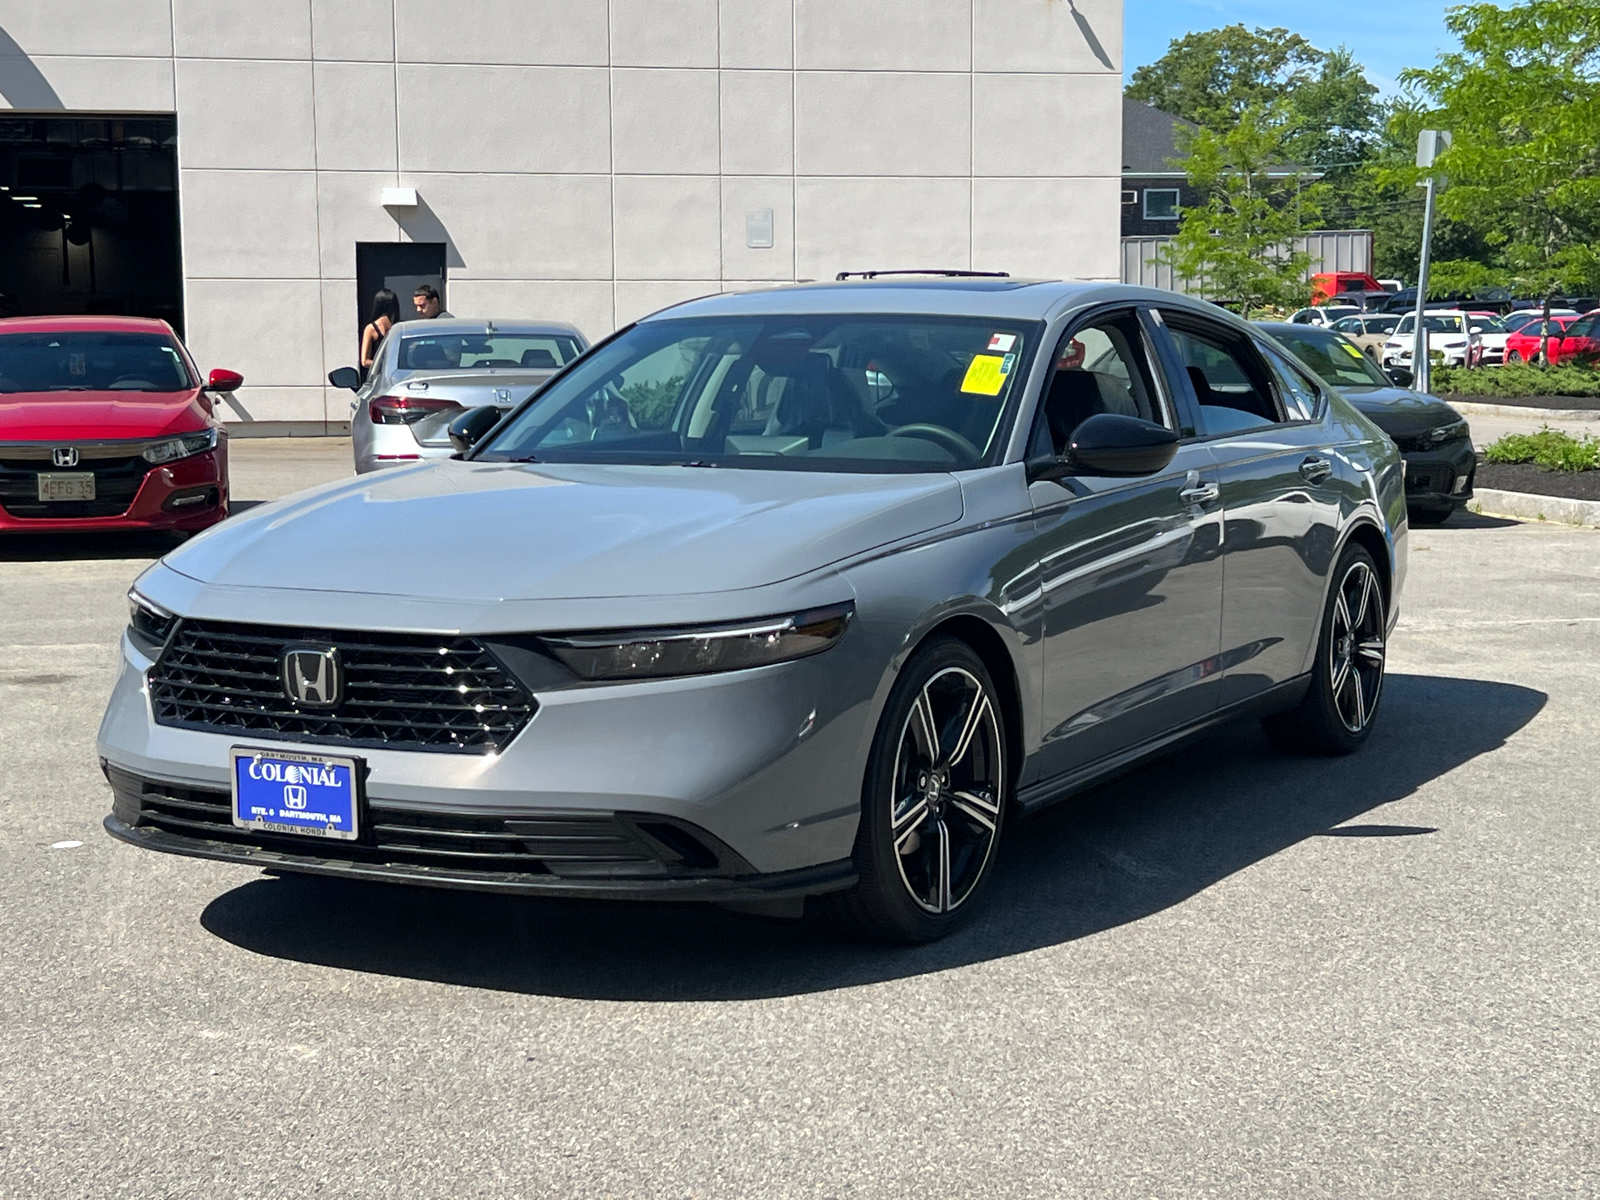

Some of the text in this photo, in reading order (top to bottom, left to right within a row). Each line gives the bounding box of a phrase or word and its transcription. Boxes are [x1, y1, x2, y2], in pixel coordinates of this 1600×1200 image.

[42, 480, 93, 495] 4EFG 35
[249, 762, 342, 787] COLONIAL
[279, 809, 329, 823] DARTMOUTH,
[329, 814, 342, 823] MA
[263, 823, 327, 836] COLONIAL HONDA
